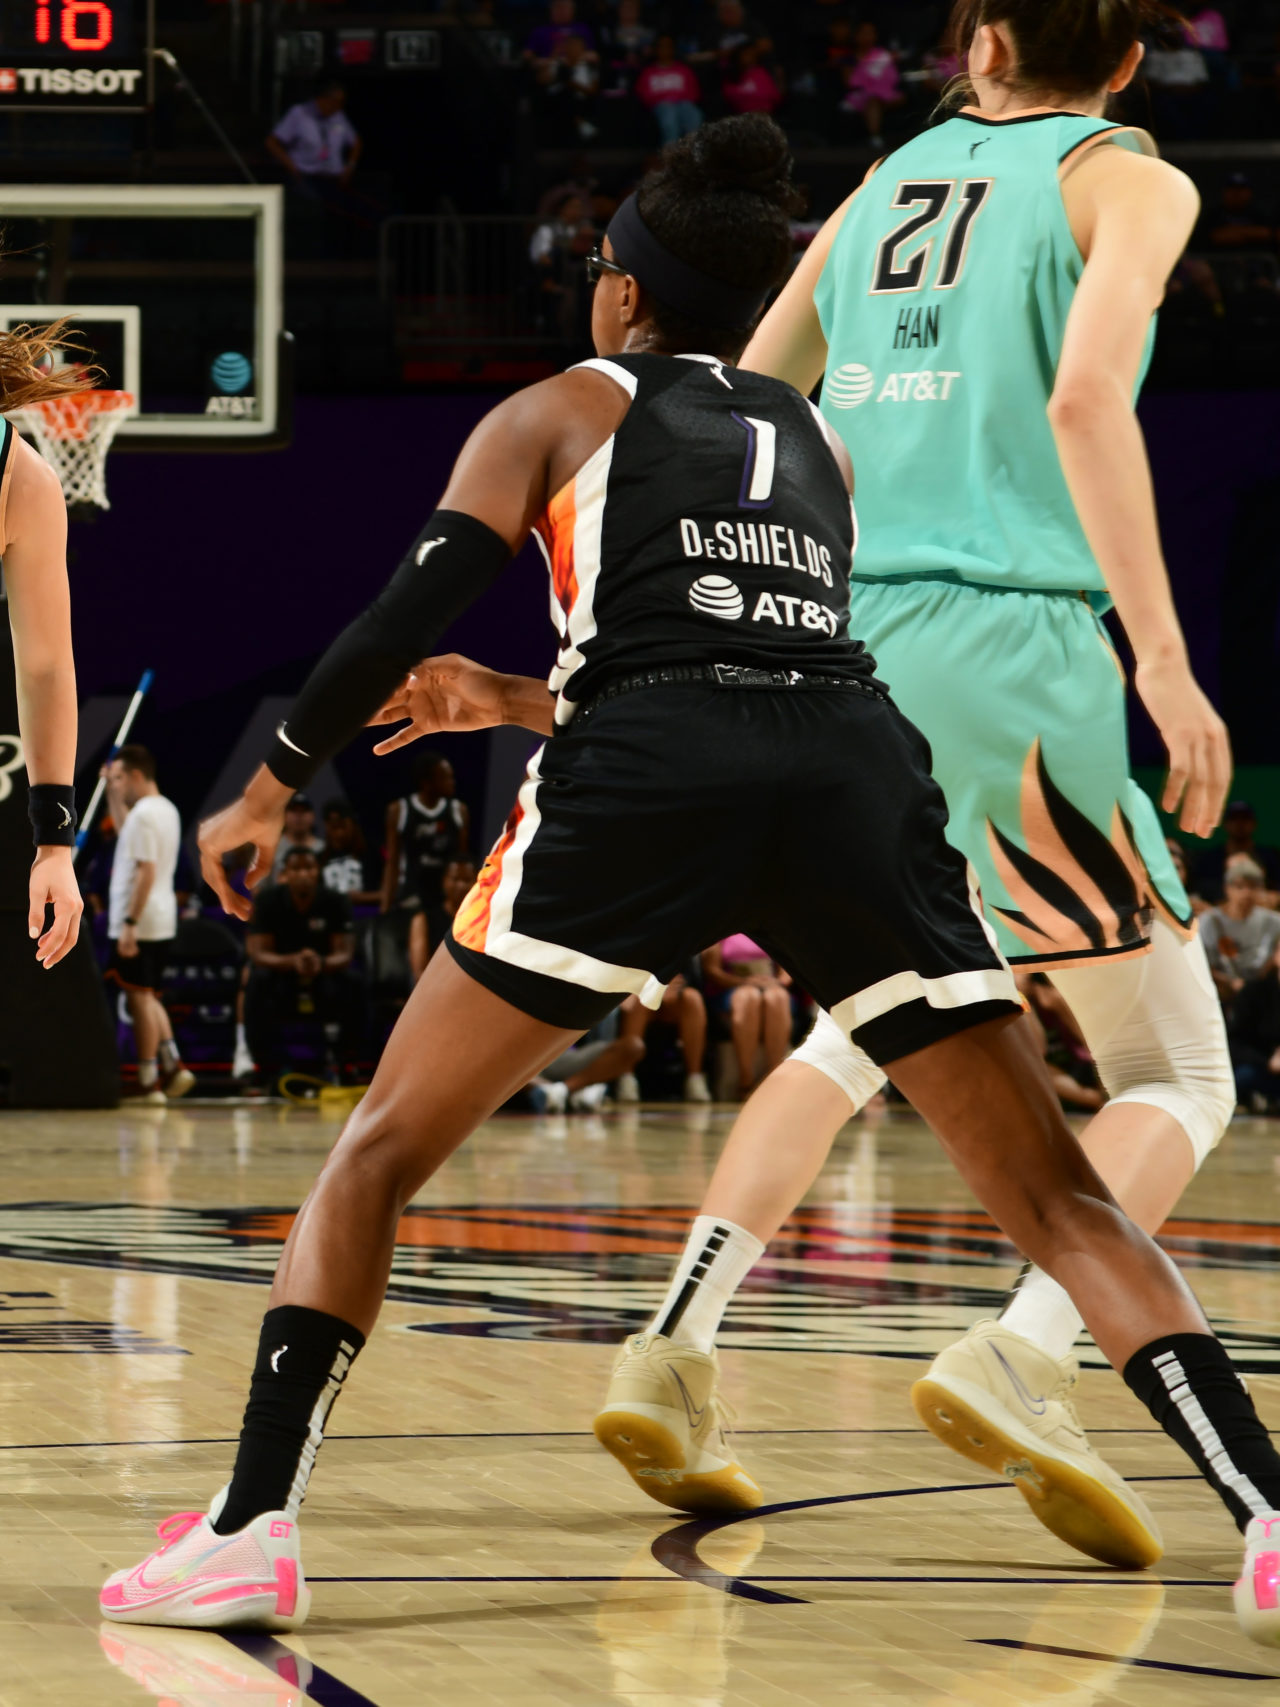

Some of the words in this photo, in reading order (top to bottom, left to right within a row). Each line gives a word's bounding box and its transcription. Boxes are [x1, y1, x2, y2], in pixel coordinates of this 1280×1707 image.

[17, 68, 142, 94] TISSOT
[868, 177, 995, 296] 21
[893, 304, 940, 349] HAN
[876, 370, 962, 402] AT&T
[735, 413, 776, 505] 1
[752, 592, 839, 638] AT&T
[269, 1520, 294, 1539] GT
